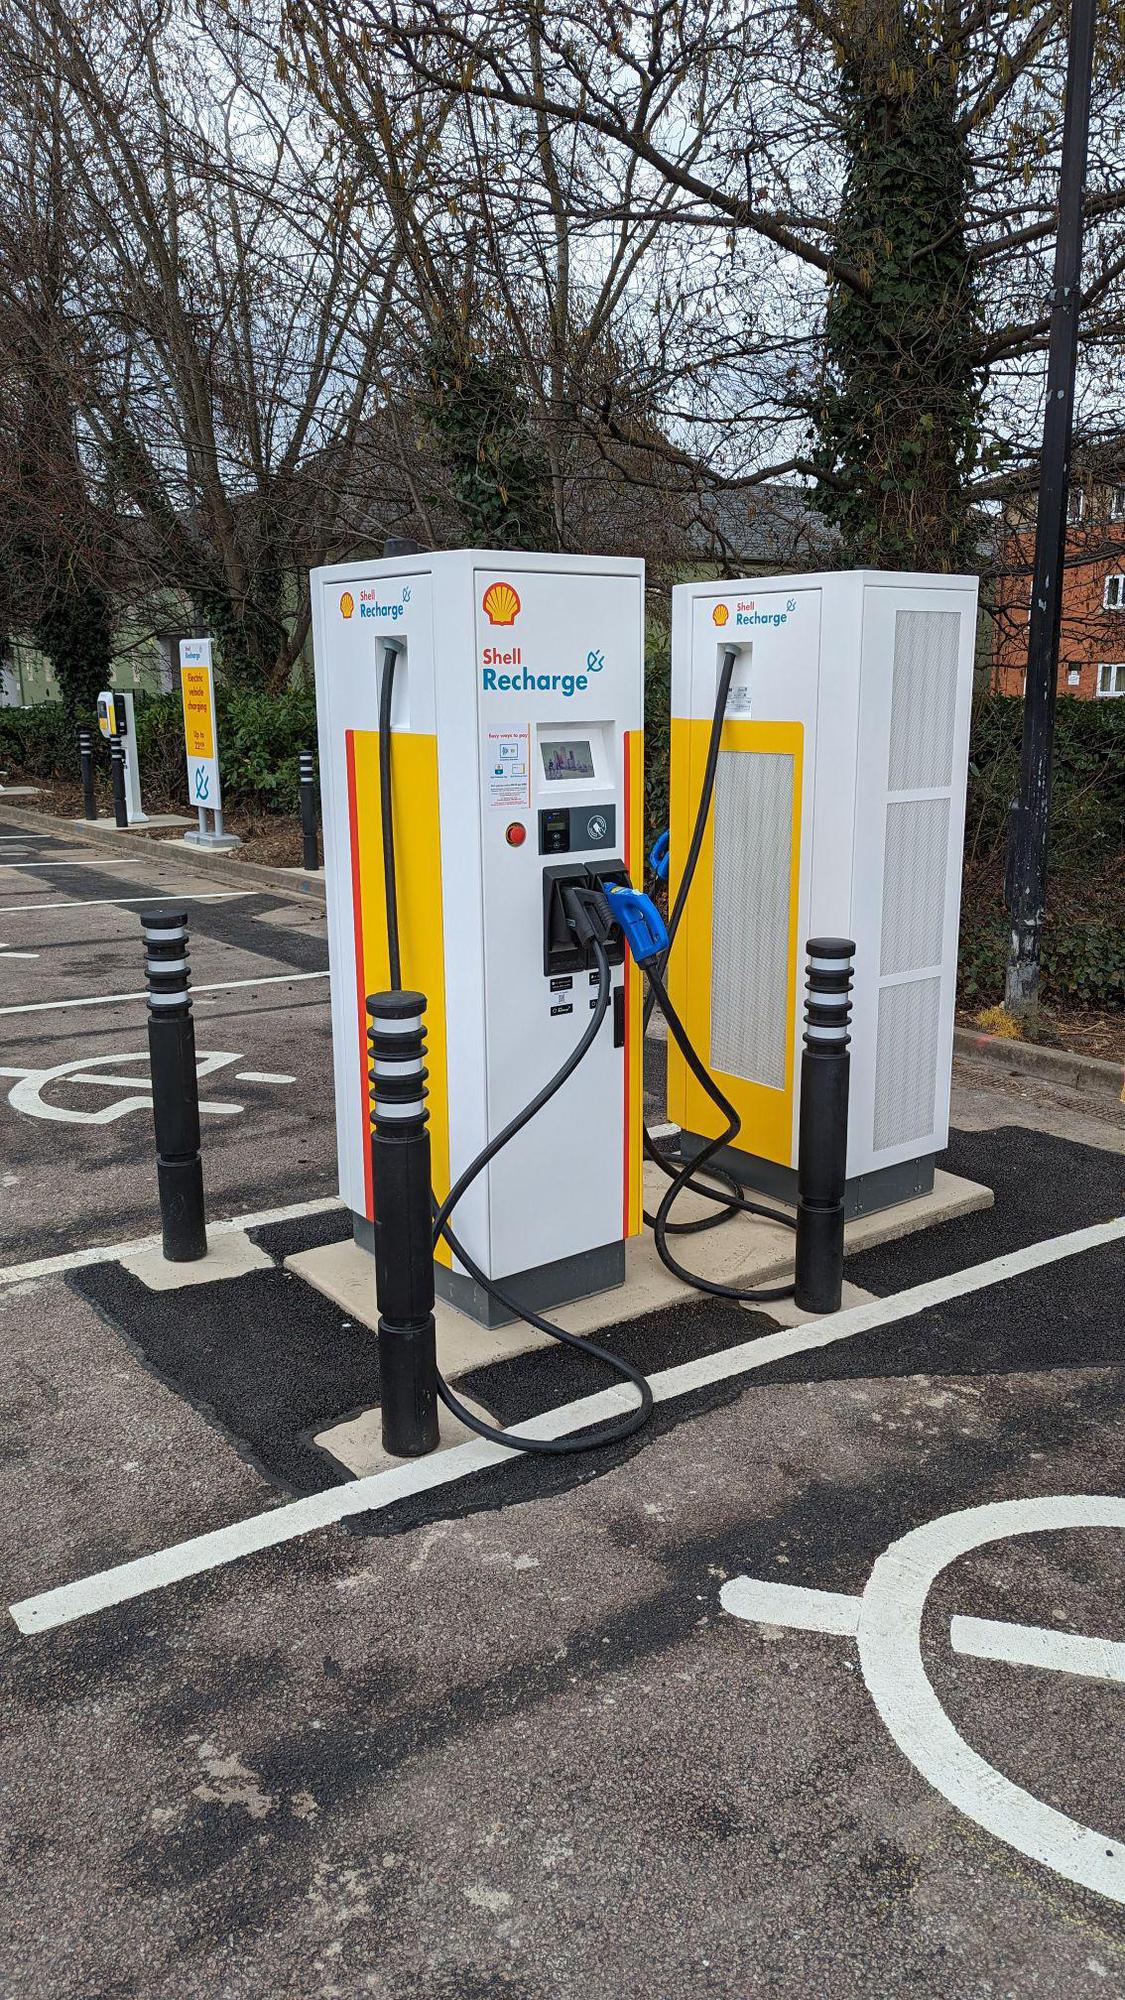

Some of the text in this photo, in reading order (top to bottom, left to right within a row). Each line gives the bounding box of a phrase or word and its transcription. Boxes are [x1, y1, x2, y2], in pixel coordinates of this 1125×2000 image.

[360, 589, 376, 601] Shell
[360, 600, 404, 620] Recharge
[737, 601, 755, 612] Shell
[736, 611, 788, 627] Recharge
[482, 648, 522, 665] Shell
[187, 672, 203, 682] Electric
[482, 667, 588, 697] Recharge
[188, 686, 205, 696] vehicle
[188, 700, 207, 713] charging
